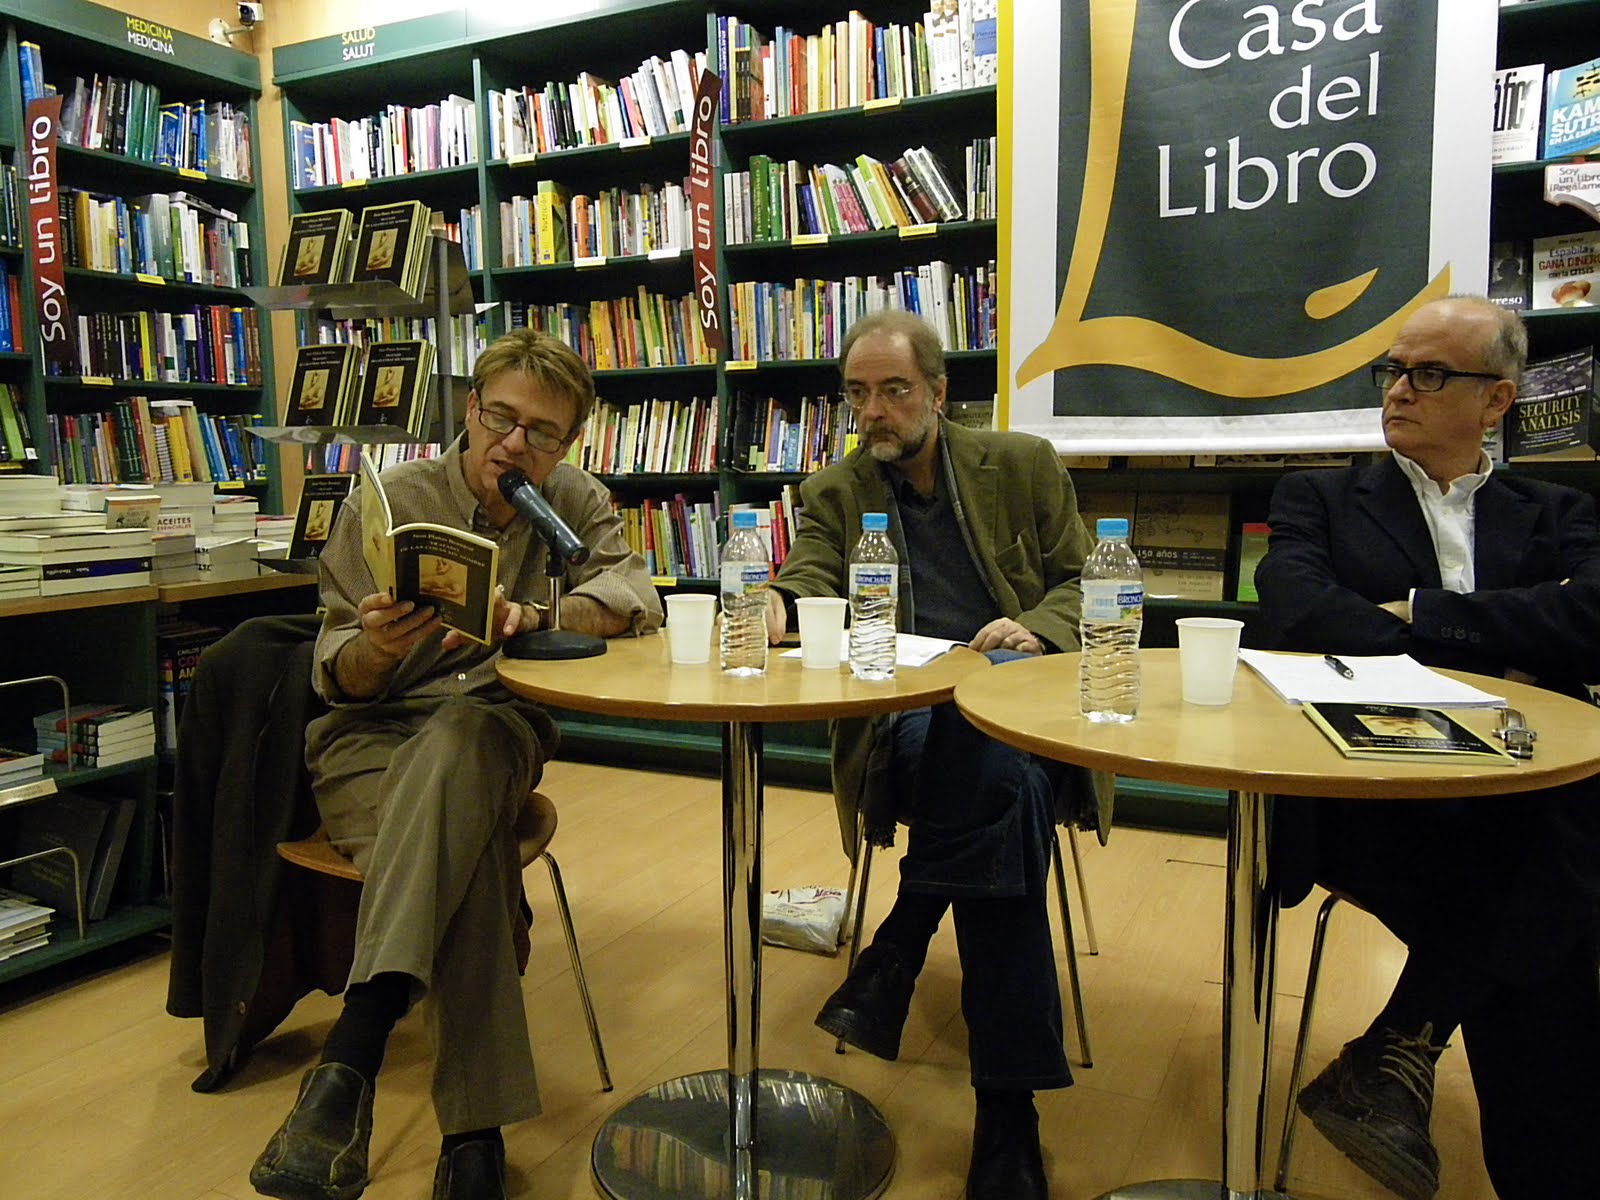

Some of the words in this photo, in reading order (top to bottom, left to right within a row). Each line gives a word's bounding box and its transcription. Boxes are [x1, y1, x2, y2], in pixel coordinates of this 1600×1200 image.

[126, 16, 174, 42] MEDICINA
[127, 31, 175, 56] MEDICINA
[341, 27, 376, 45] SALUD
[1168, 0, 1384, 70] Casa
[342, 42, 376, 61] SALUT
[1268, 51, 1380, 130] del
[691, 95, 712, 188] libro
[28, 115, 51, 205] libro
[1559, 167, 1579, 176] Soy
[1158, 136, 1377, 218] Libro
[541, 194, 549, 232] Nutrición
[697, 202, 711, 251] un
[37, 217, 54, 264] un
[1538, 258, 1565, 271] GANA
[41, 276, 66, 342] Soy
[699, 260, 718, 330] Soy
[1518, 409, 1581, 432] ANALYSIS
[1519, 394, 1582, 418] SECURITY
[157, 516, 192, 526] ACEITES
[1137, 549, 1153, 559] 150
[1156, 549, 1178, 559] años
